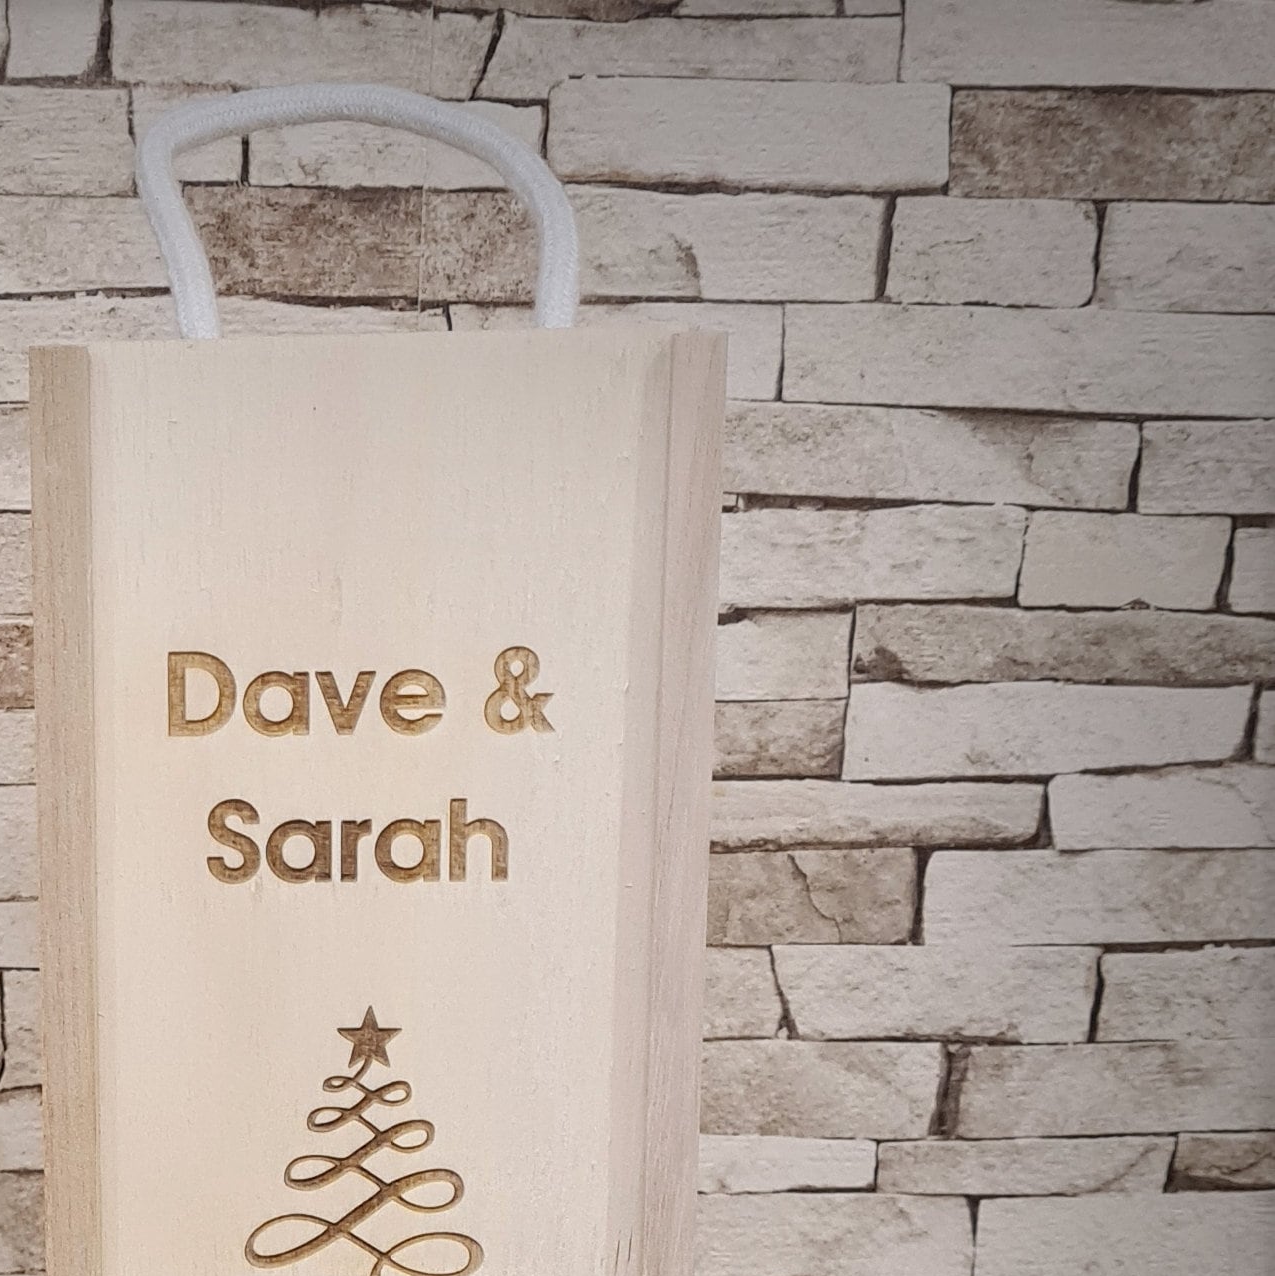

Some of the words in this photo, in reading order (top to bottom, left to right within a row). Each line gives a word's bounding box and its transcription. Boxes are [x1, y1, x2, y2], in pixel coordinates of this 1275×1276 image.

[167, 650, 447, 738] Dave
[482, 645, 556, 734] &
[206, 797, 510, 885] Sarah
